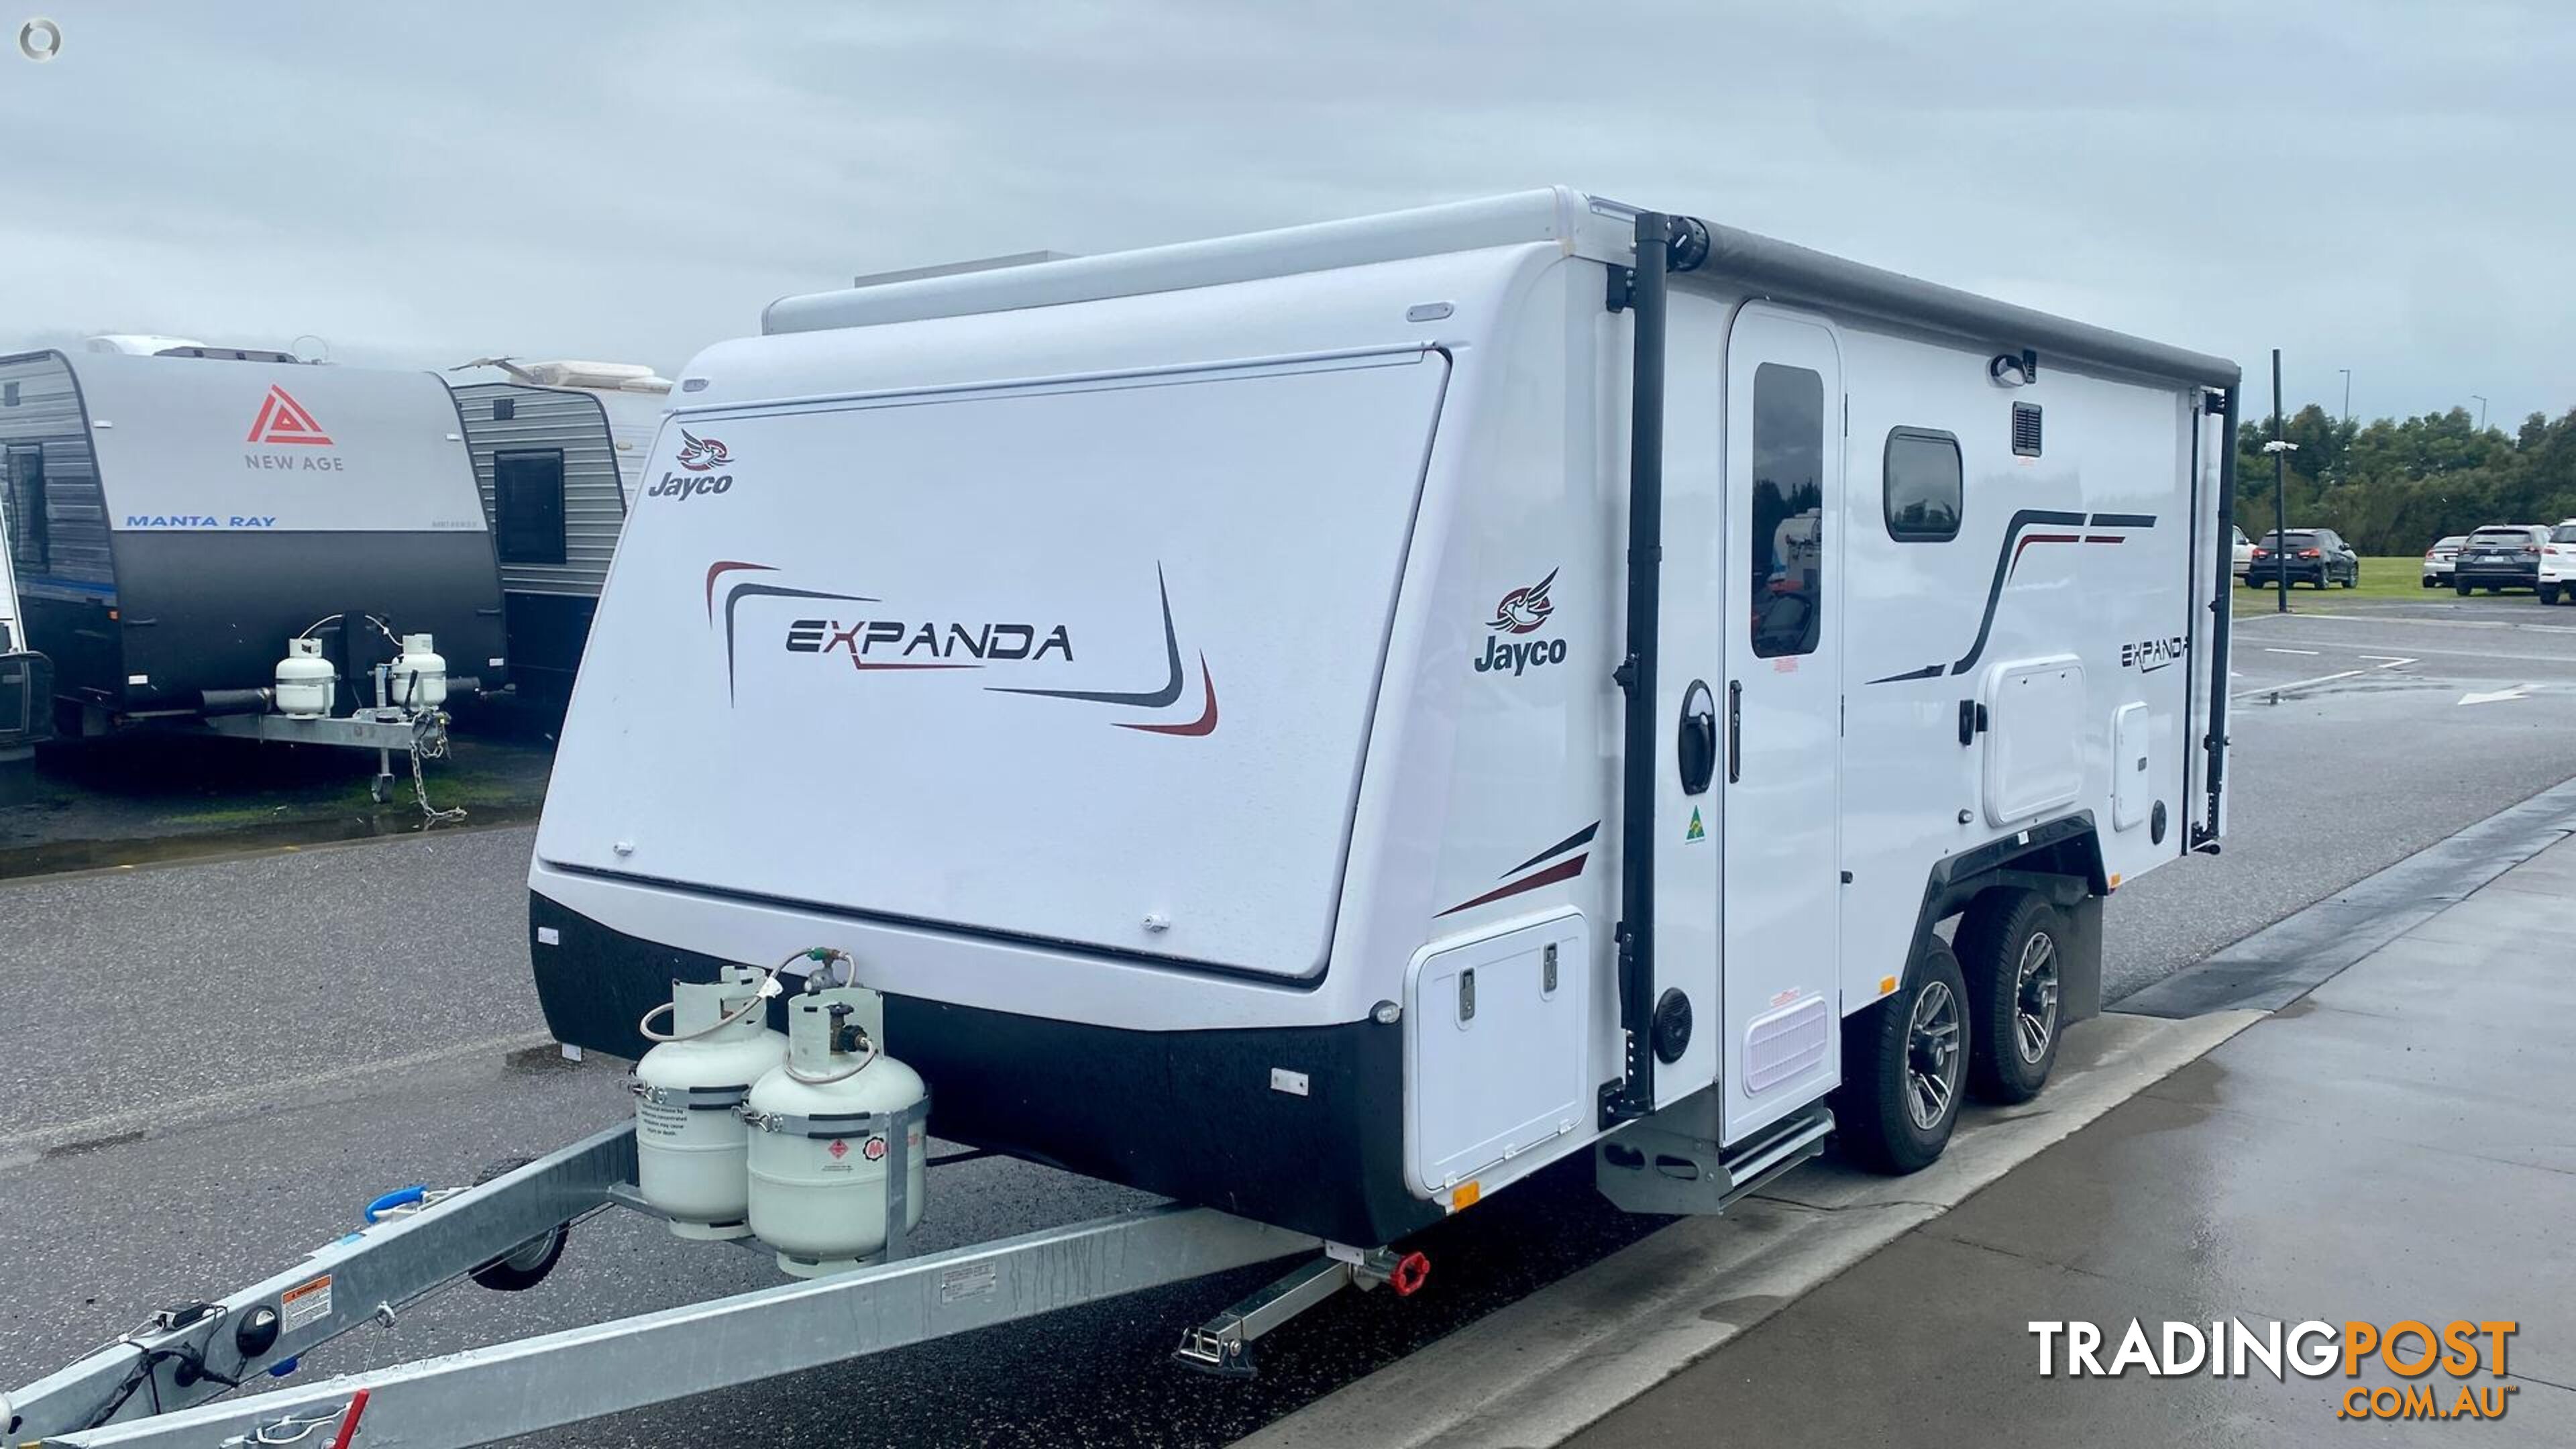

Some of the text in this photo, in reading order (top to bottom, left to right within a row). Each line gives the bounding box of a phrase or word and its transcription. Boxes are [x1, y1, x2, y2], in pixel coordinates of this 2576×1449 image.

[245, 454, 344, 472] NEW AGE
[648, 472, 733, 501] Jayco
[126, 515, 277, 527] MANTA RAY
[786, 619, 1074, 670] EXPANDA
[1474, 635, 1567, 677] Jayco
